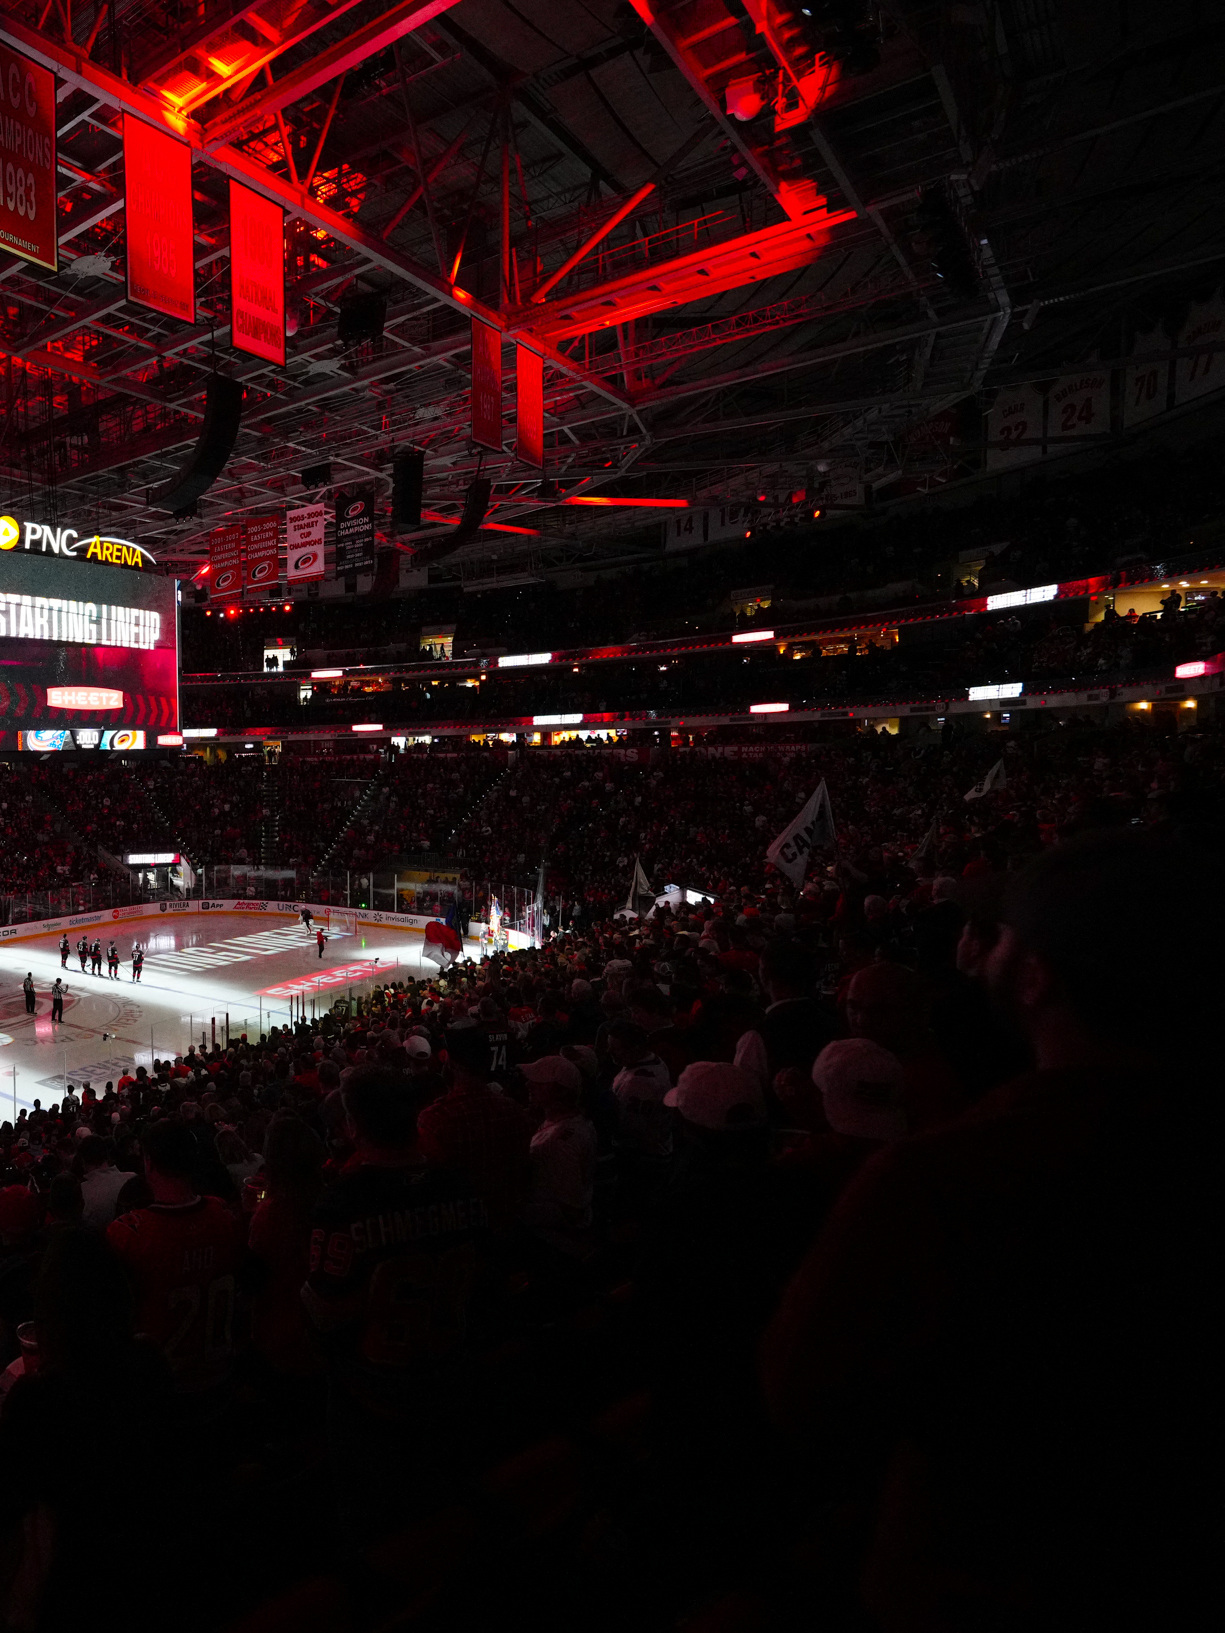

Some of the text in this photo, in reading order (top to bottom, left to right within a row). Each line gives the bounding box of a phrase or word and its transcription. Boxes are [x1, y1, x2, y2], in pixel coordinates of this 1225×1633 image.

[146, 230, 177, 278] 1985
[239, 273, 279, 314] NATIONAL
[236, 308, 282, 350] CHAMPIONS
[1054, 377, 1105, 403] BURLESON
[1135, 369, 1158, 408] 70
[1061, 396, 1095, 432] 24
[289, 510, 323, 524] 2005-2006
[339, 516, 370, 529] DIVISION
[247, 521, 277, 534] 2005-2006
[293, 520, 319, 532] STANLEY
[337, 523, 373, 537] CHAMPIONS
[676, 515, 694, 537] 14
[251, 531, 273, 542] EASTERN
[299, 530, 312, 539] CUP
[24, 522, 143, 568] PNC ARENA
[214, 542, 236, 552] EASTERN
[248, 539, 277, 551] CONFERENCE
[289, 538, 323, 550] CHAMPIONS
[211, 550, 239, 562] CONFERENCE
[248, 548, 277, 560] CHAMPIONS
[212, 558, 240, 569] CHAMPIONS
[101, 604, 160, 650] LINEUP
[1176, 663, 1204, 675] SHEETZ
[50, 690, 120, 706] SHEETZ
[158, 736, 183, 745] SHEETZ
[277, 903, 299, 912] UNC
[69, 914, 102, 925] ticketmaster
[385, 915, 418, 925] invisalign
[266, 960, 393, 998] SHEETZ
[490, 1045, 508, 1072] 74
[183, 1246, 217, 1273] AHO
[309, 1228, 353, 1277] 69
[166, 1274, 236, 1367] 20
